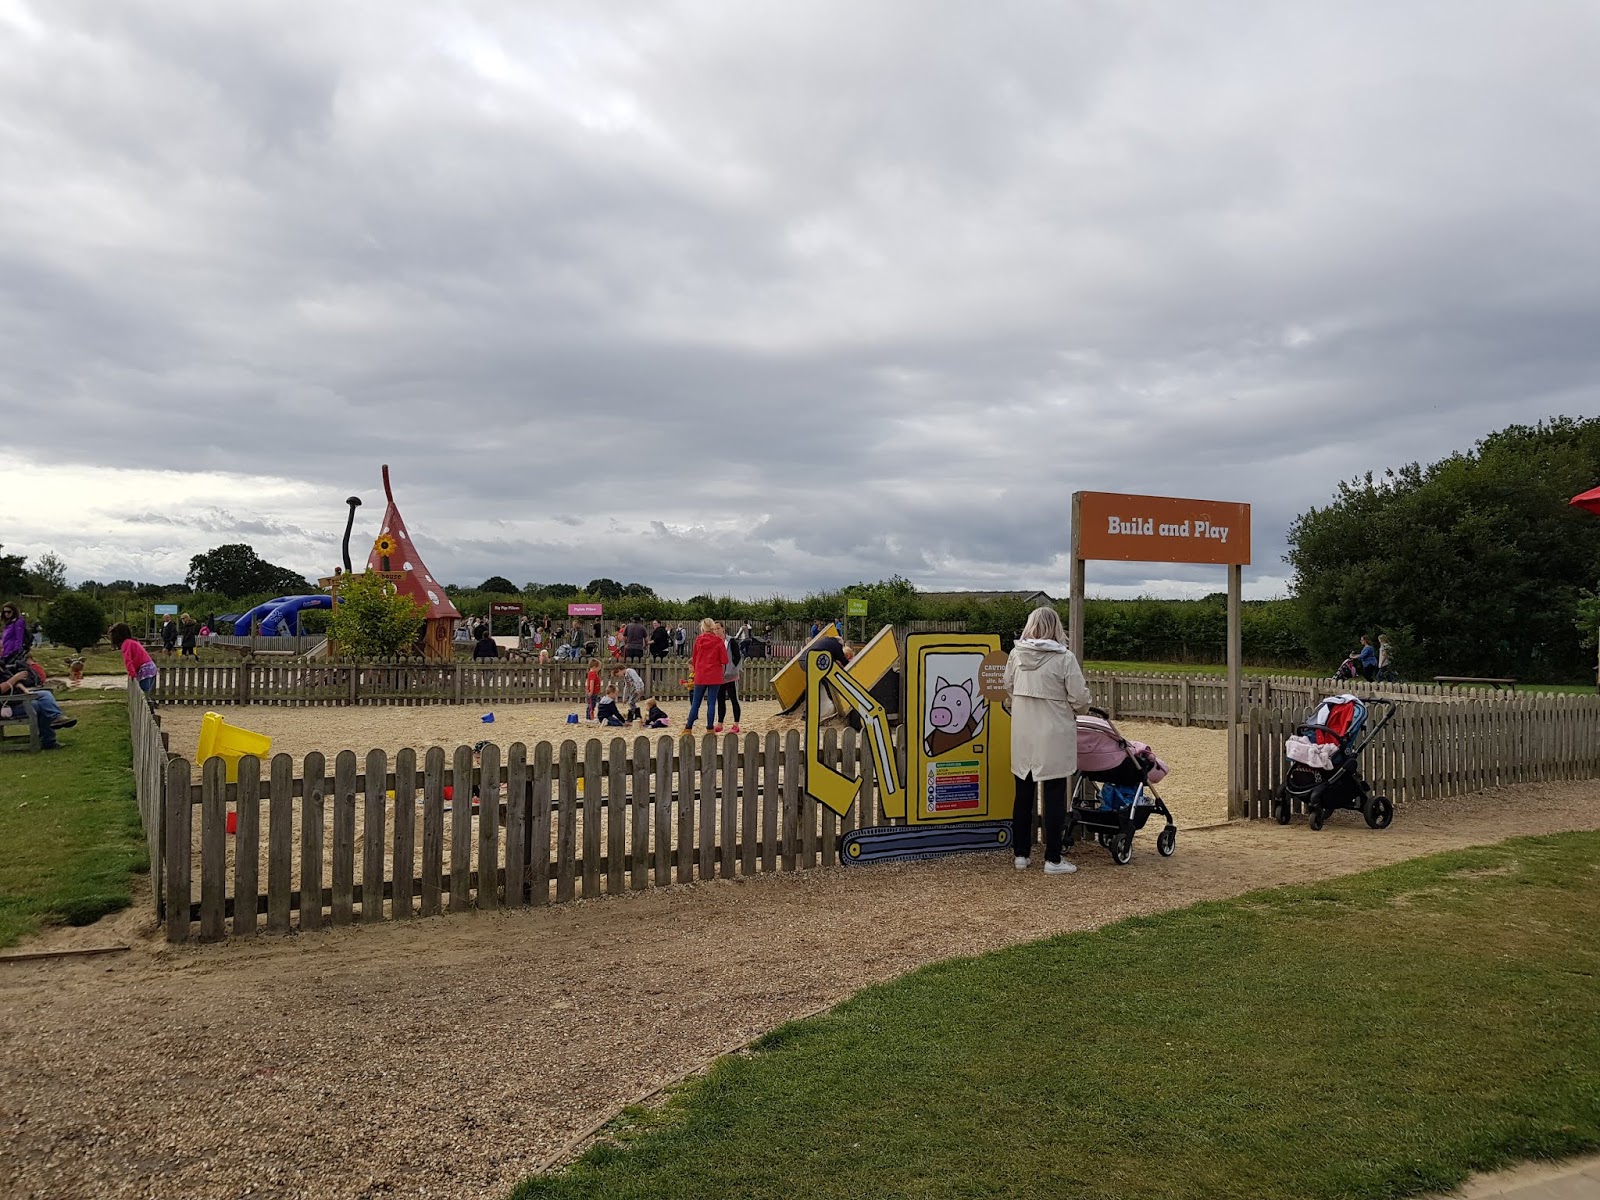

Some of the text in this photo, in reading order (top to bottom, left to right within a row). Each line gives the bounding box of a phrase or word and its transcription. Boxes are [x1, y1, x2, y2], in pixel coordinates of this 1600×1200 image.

[1107, 516, 1229, 543] Build and Play
